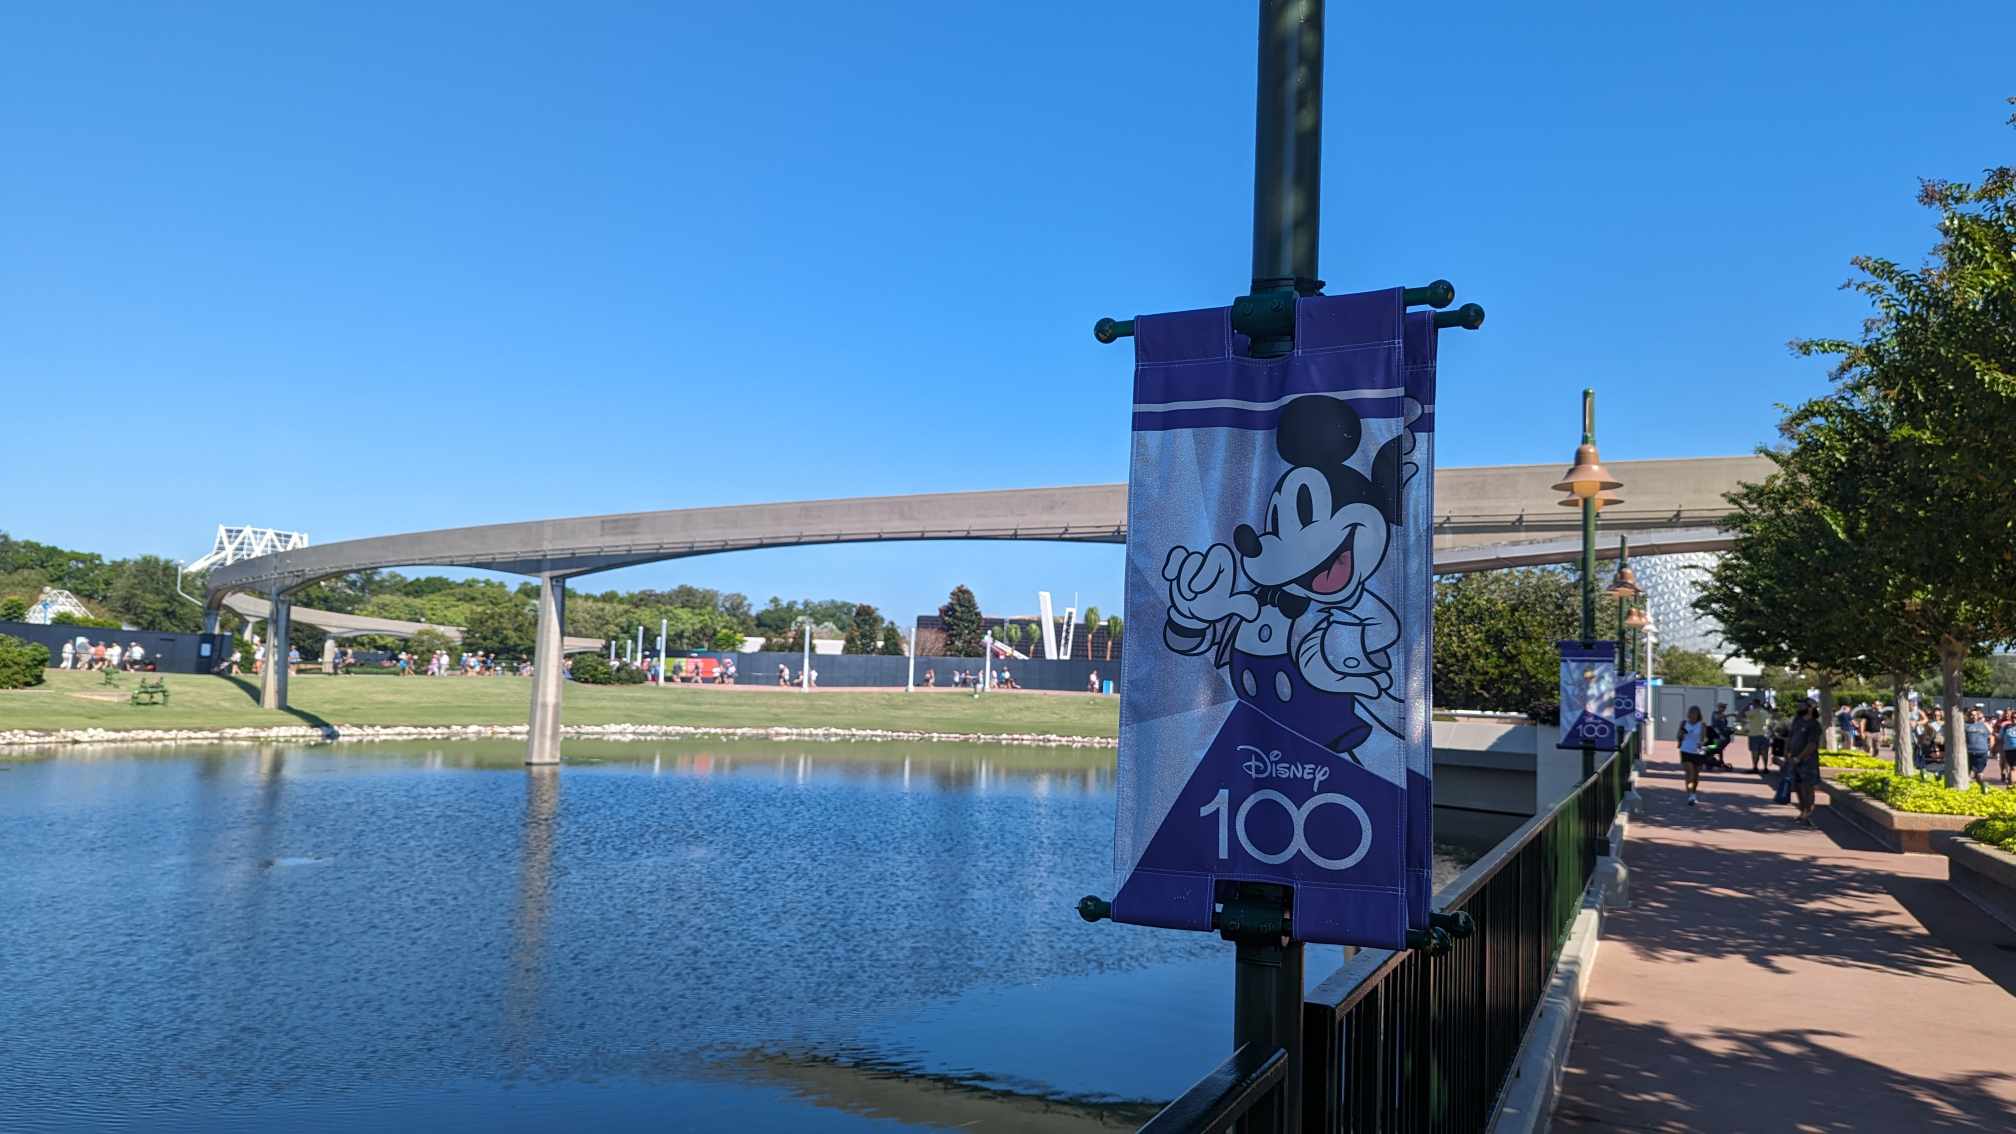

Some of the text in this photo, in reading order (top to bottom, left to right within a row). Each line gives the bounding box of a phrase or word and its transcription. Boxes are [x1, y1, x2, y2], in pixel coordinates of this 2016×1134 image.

[1576, 723, 1609, 738] 100
[1236, 745, 1330, 792] Disney
[1199, 788, 1373, 871] 100
